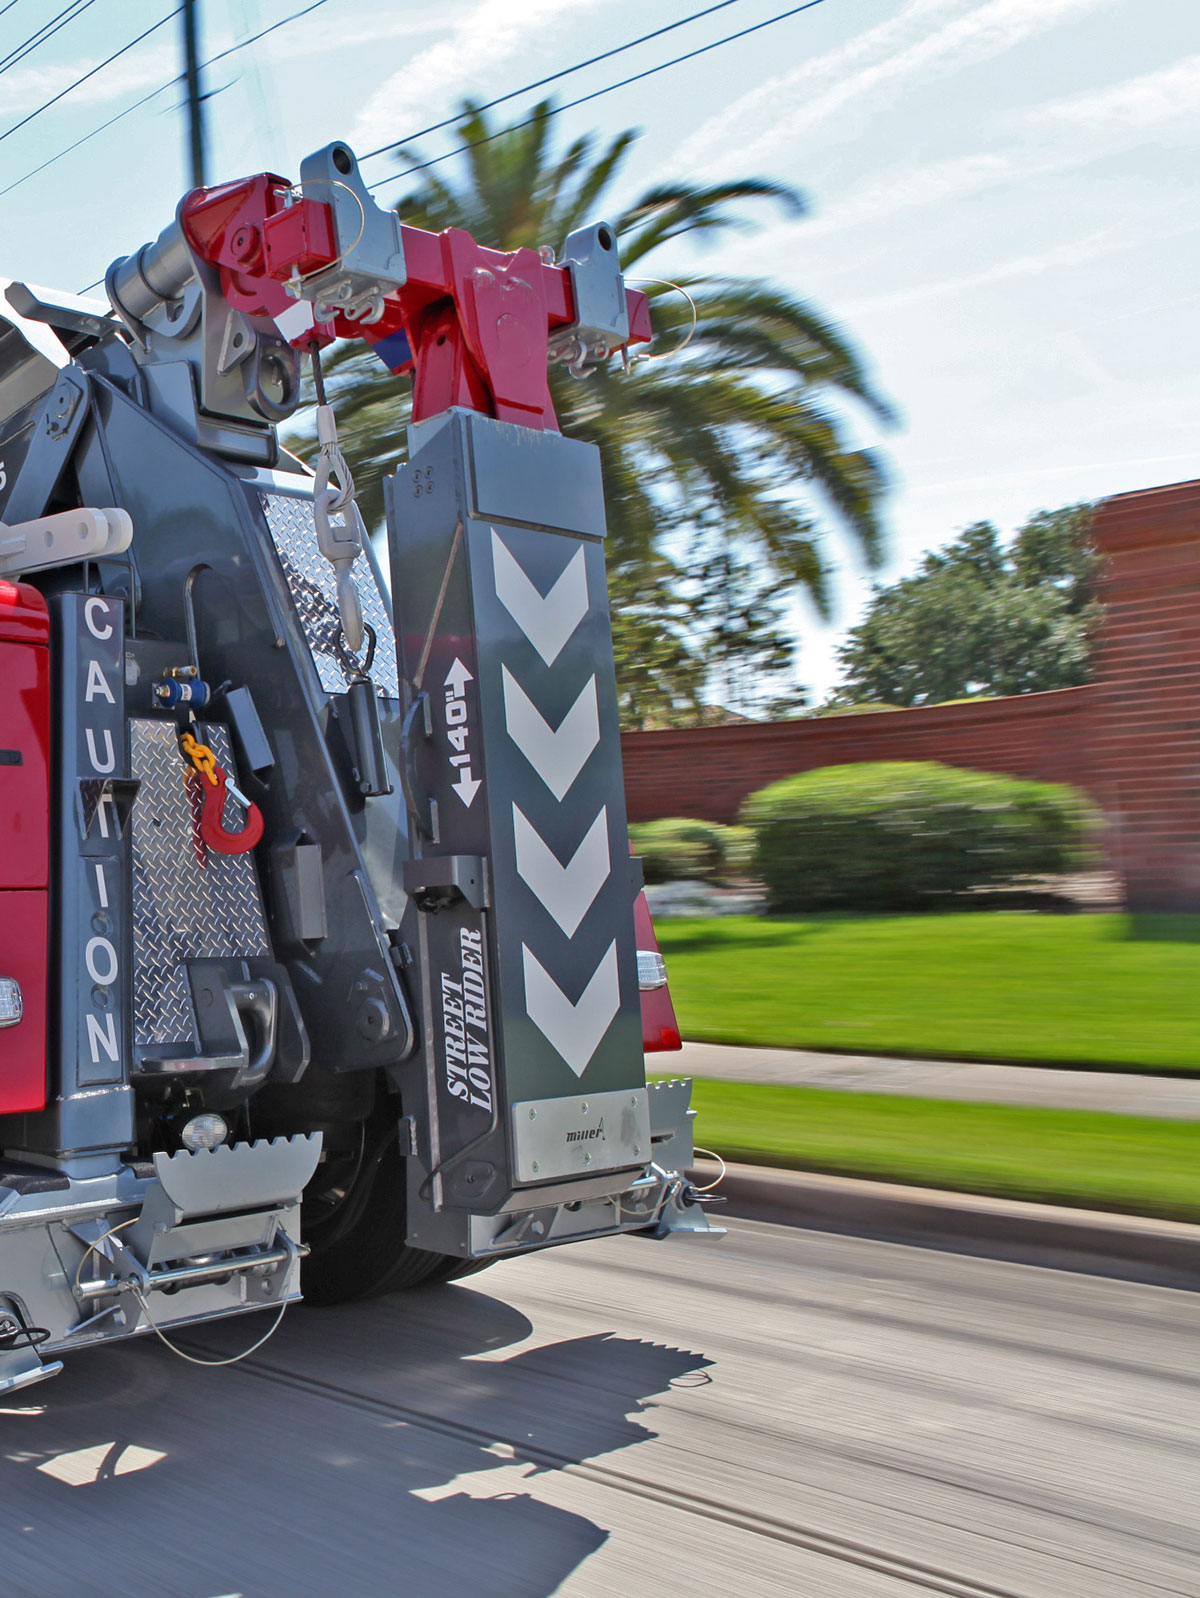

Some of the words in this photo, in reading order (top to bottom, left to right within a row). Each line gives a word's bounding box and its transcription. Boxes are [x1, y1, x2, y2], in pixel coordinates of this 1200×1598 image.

[85, 597, 119, 1063] CAUTION
[441, 972, 469, 1102] STREET
[460, 927, 488, 1032] RIDER
[467, 1032, 492, 1113] LOW
